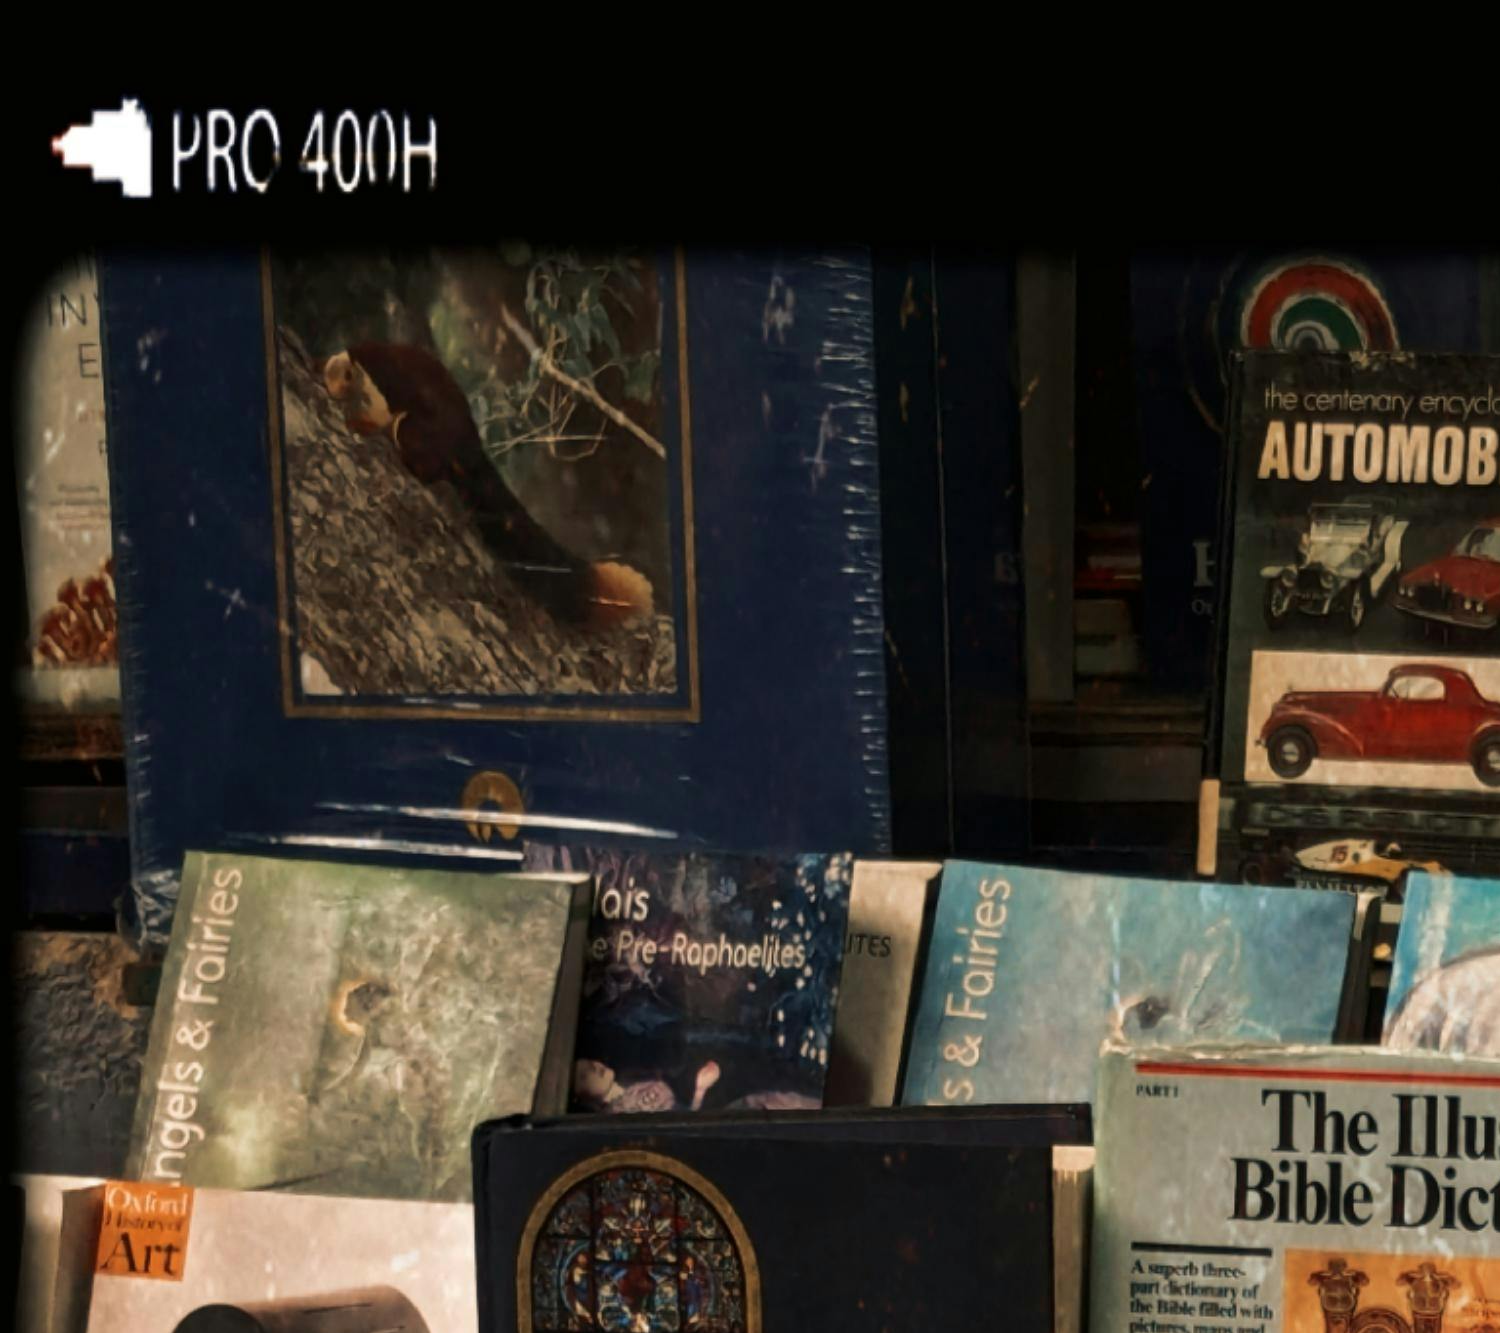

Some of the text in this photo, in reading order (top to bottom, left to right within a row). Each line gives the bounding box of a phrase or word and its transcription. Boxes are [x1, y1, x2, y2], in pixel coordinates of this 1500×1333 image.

[1265, 382, 1297, 410] the
[1303, 386, 1413, 422] centenary
[615, 930, 807, 970] Pre-Raphaelites
[944, 875, 1012, 1021] Fairies
[147, 866, 244, 1188] ngels & Fairies
[943, 1034, 983, 1069] &
[1136, 1083, 1172, 1099] PART
[1260, 1088, 1378, 1156] The
[107, 1184, 190, 1217] Oxford
[1228, 1157, 1374, 1227] Bible
[101, 1231, 181, 1277] Art
[1130, 1259, 1145, 1274] A
[1148, 1261, 1198, 1280] superb
[1129, 1281, 1260, 1302] part dictionary of
[1129, 1300, 1274, 1320] the Bible filled with
